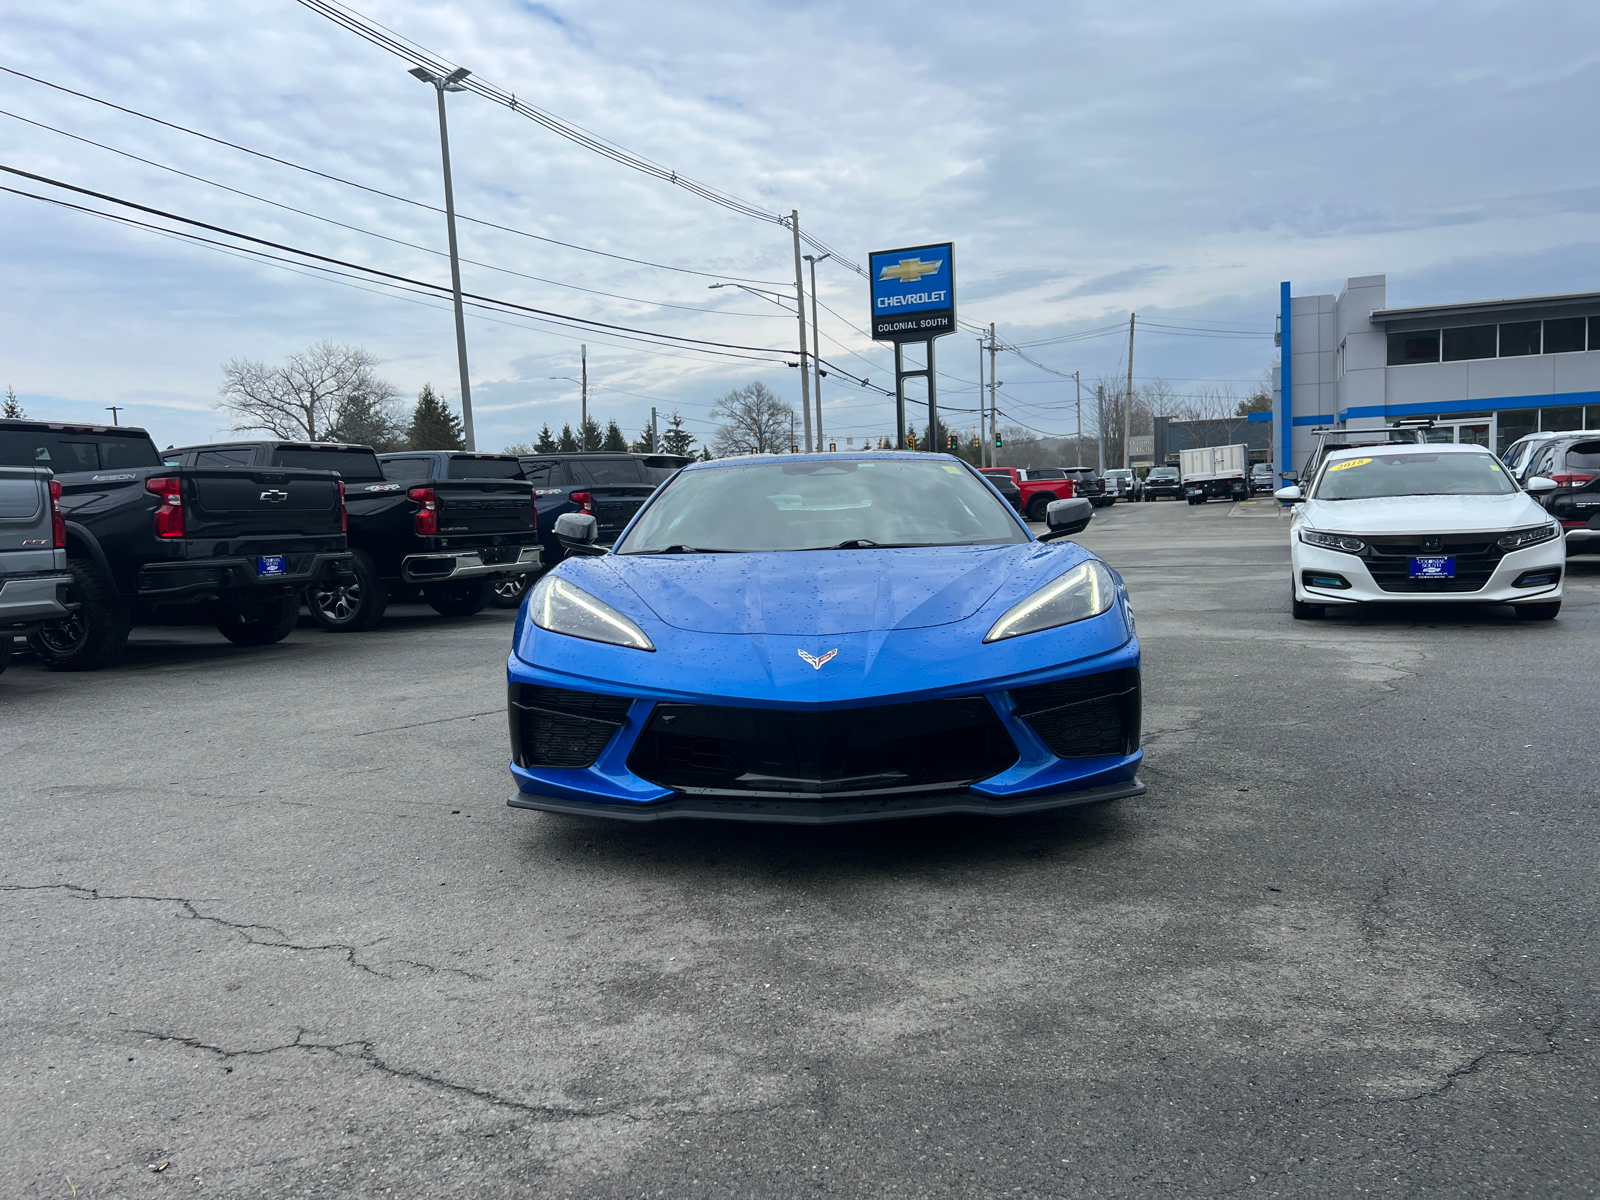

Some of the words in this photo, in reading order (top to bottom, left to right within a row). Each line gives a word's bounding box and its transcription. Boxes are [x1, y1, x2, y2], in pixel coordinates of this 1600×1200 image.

[877, 290, 947, 308] CHEVROLET
[877, 321, 918, 332] COLONIAL
[920, 318, 948, 328] SOUTH
[1337, 459, 1364, 469] 2018
